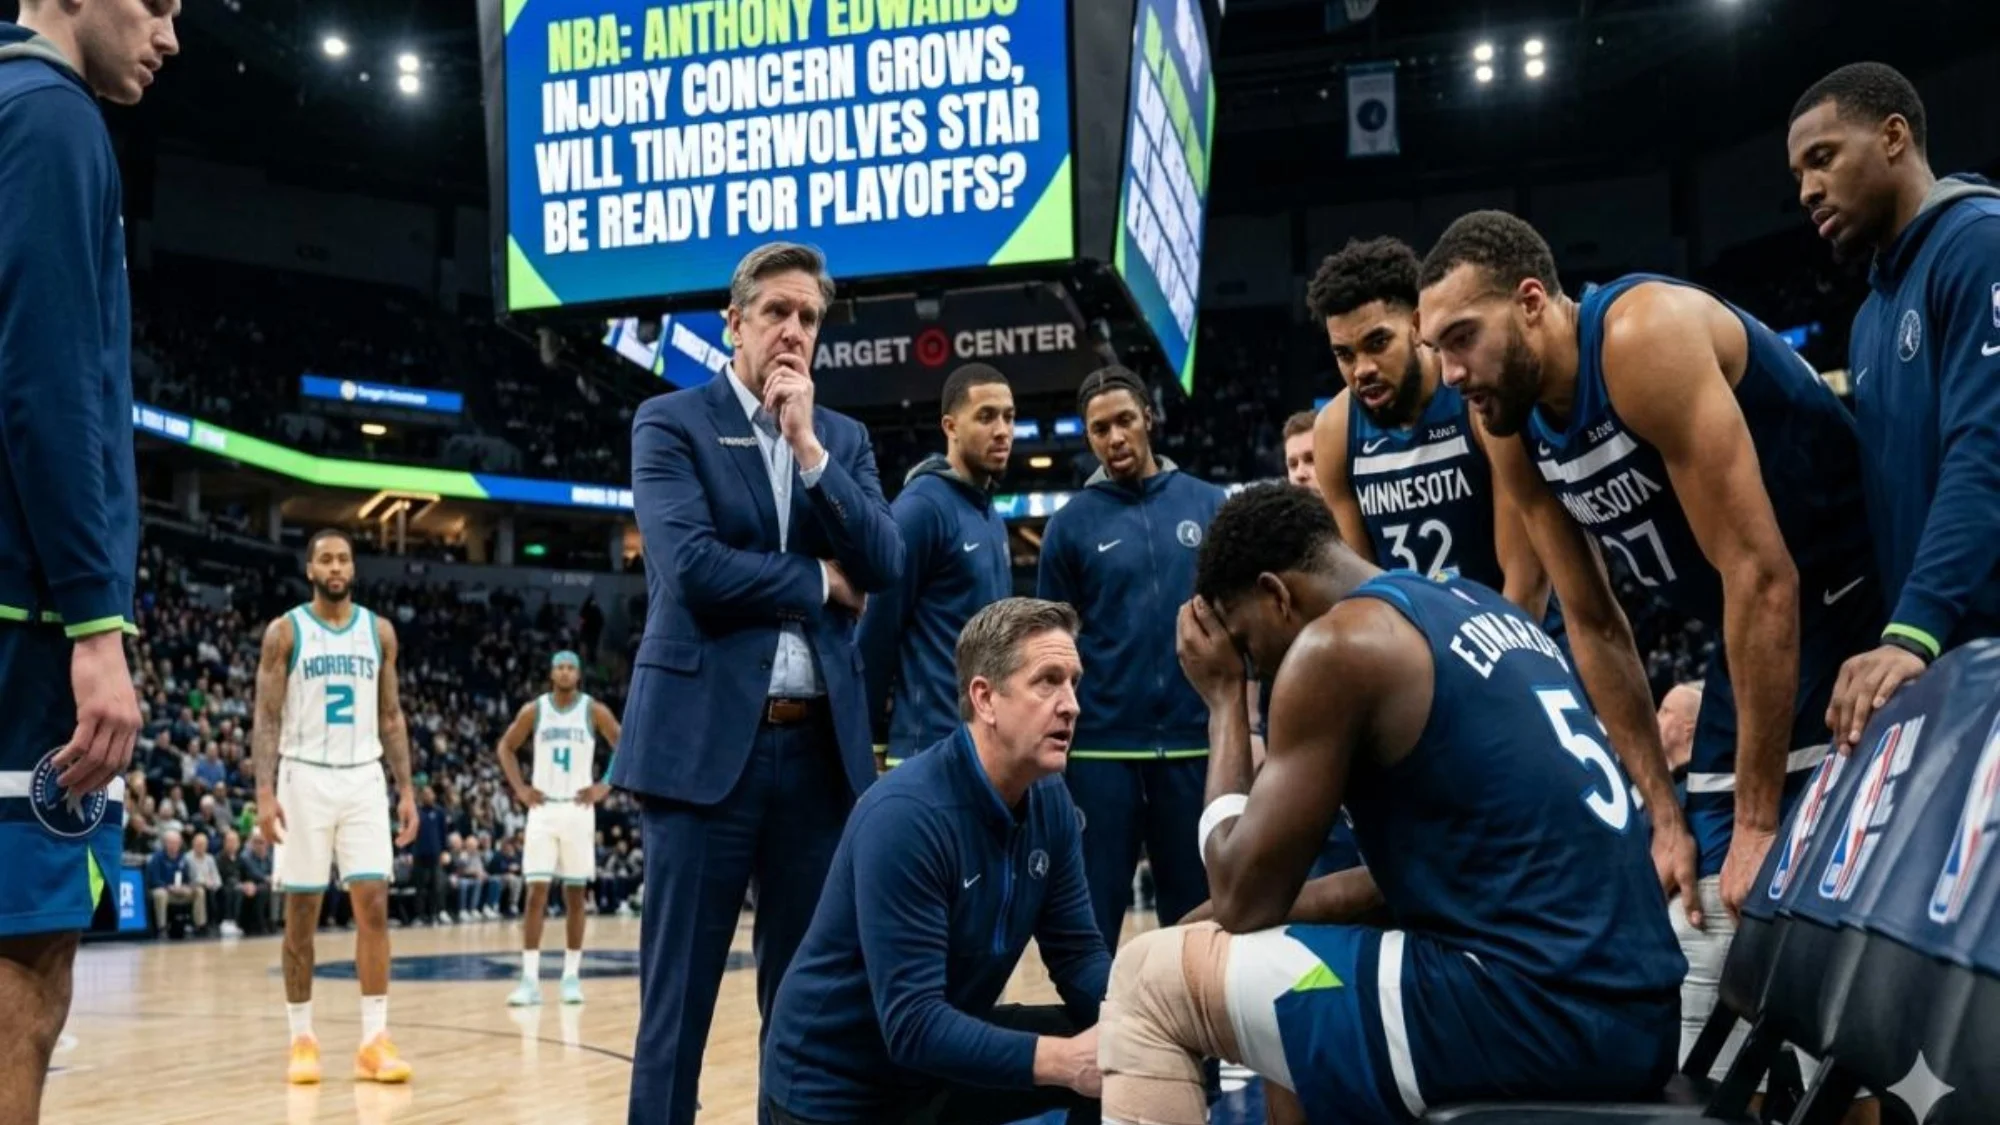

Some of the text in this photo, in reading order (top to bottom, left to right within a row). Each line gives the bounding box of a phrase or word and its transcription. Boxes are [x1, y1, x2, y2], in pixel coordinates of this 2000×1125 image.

[548, 13, 632, 74] NBA:
[643, 0, 811, 61] ANTHONY
[542, 24, 1025, 135] INJURY CONCERN GROWS,
[535, 86, 1040, 195] WILL TIMBERWOLVES STAR
[544, 151, 1027, 255] BE READY FOR PLAYOFFS?
[813, 323, 1076, 370] ARGET CENTER
[1355, 466, 1473, 516] MINNESOTA
[1381, 519, 1460, 580] 32
[302, 654, 375, 680] HORNETS
[326, 685, 354, 724] 2
[553, 747, 570, 773] 4
[1535, 689, 1628, 830] 5
